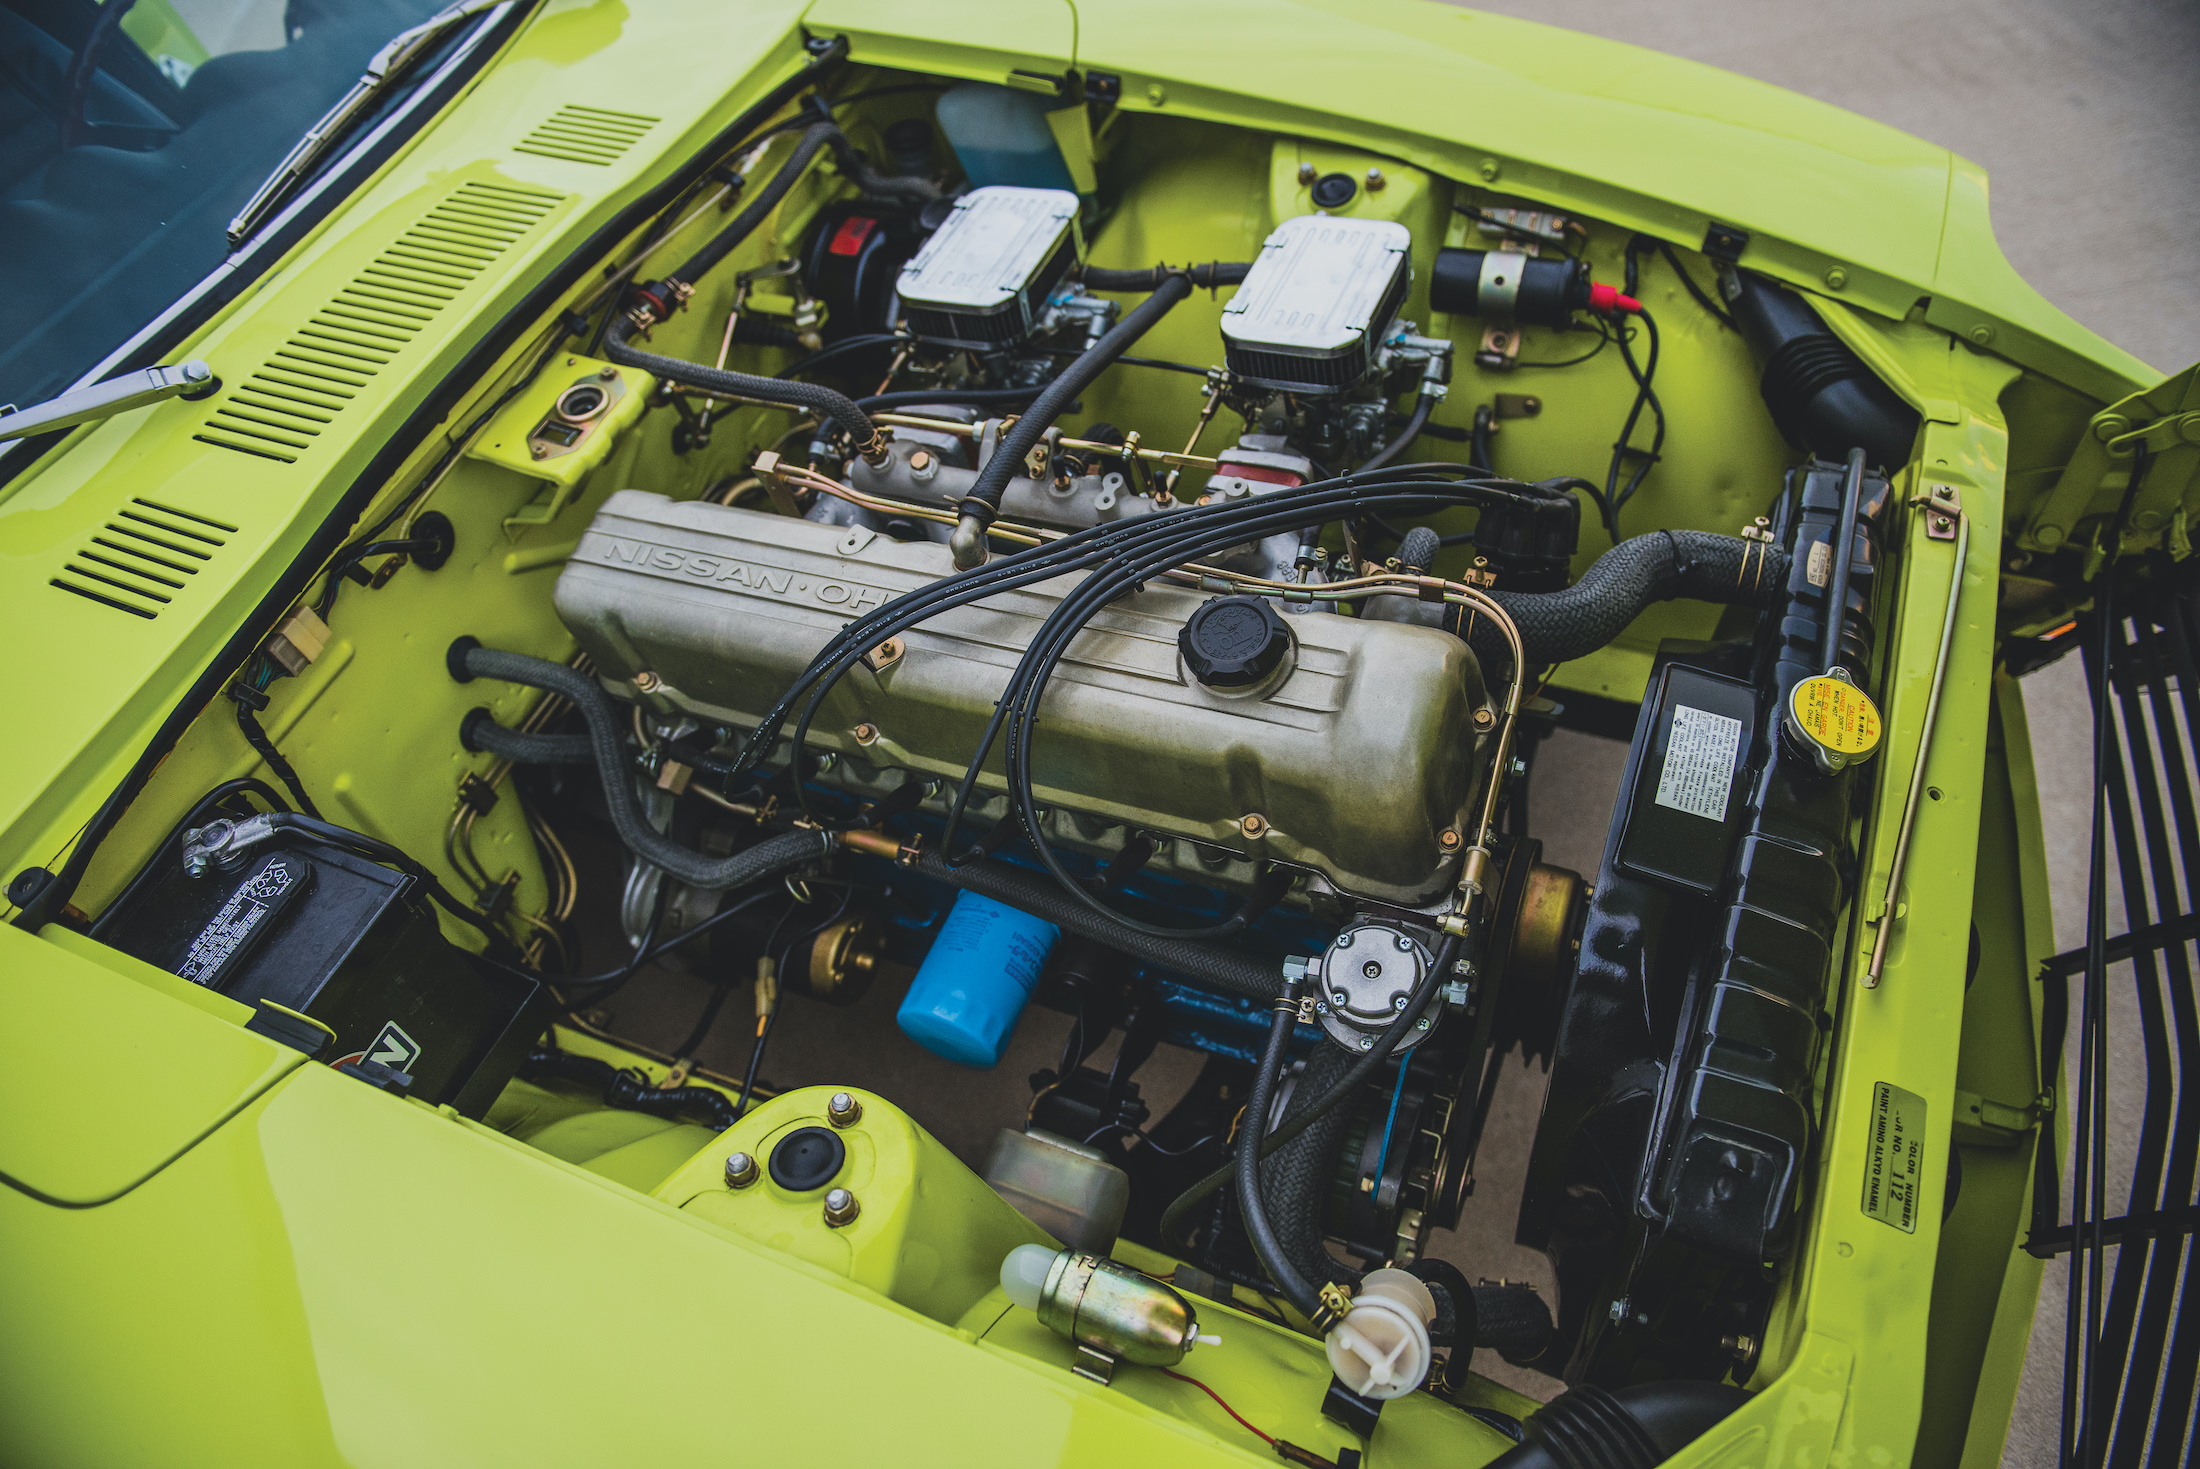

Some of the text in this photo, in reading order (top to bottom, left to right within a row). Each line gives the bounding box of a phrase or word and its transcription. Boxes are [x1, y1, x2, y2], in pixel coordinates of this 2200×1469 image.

[604, 540, 889, 608] NISSAN OH
[946, 580, 979, 594] SUMITOMO
[816, 650, 842, 672] SUMITOMO
[1822, 701, 1828, 711] EN
[1838, 692, 1846, 712] DANGER
[1820, 714, 1828, 736] GARDE
[1848, 705, 1856, 733] CAUTION
[1010, 723, 1018, 760] SUMITOMO
[1670, 730, 1679, 747] NISSAN
[1677, 732, 1685, 751] COOLANT
[1724, 720, 1732, 744] ANTIFREEZE
[1666, 749, 1675, 767] MOTOR
[1718, 752, 1726, 777] INSTALLED
[1724, 753, 1733, 779] COMPANY'S
[1710, 760, 1718, 782] COOLANT
[1672, 783, 1680, 801] NISSAN
[1716, 794, 1725, 817] COOLANT
[1868, 1087, 1890, 1214] PAINT AMINO ALKYD ENAMEL
[1892, 1134, 1902, 1156] NO.
[1890, 1170, 1905, 1202] 112
[1902, 1140, 1918, 1228] COLOR NUMBER
